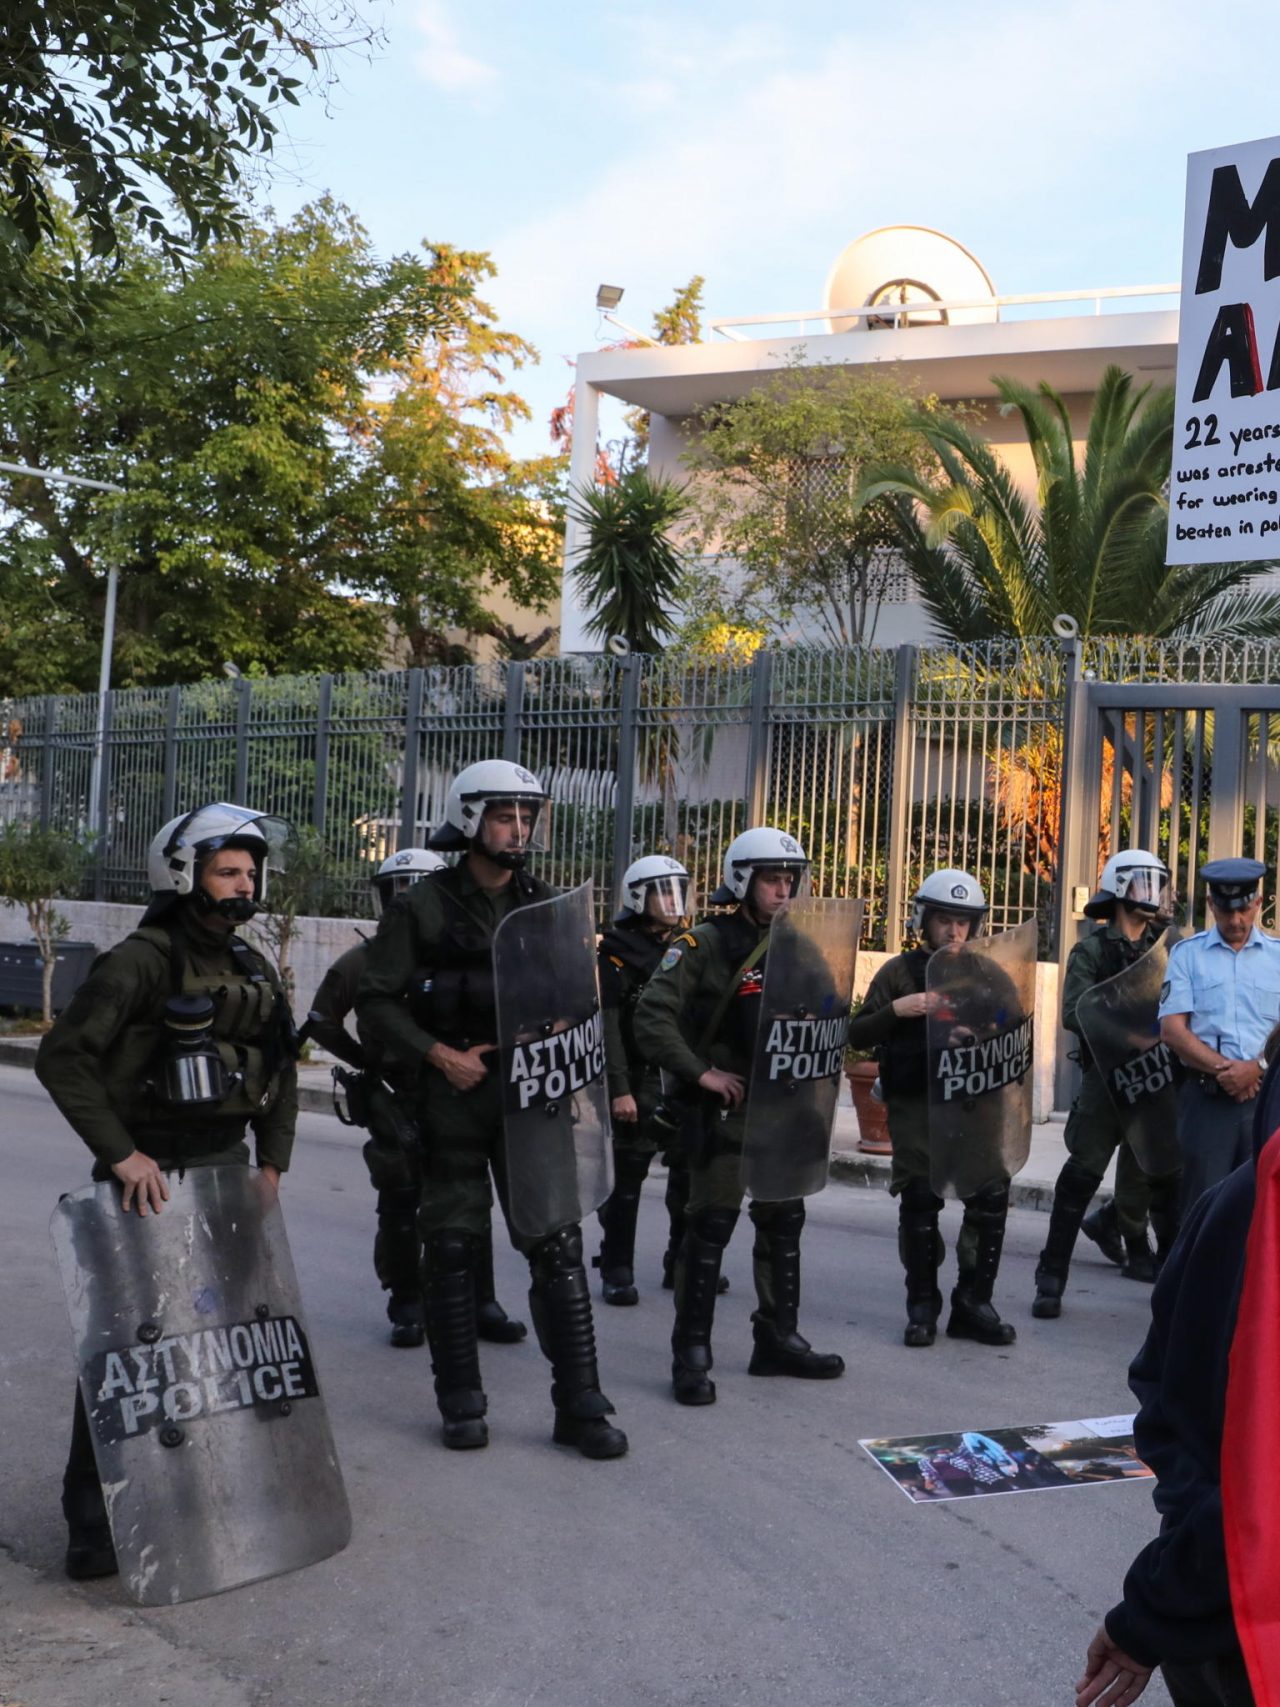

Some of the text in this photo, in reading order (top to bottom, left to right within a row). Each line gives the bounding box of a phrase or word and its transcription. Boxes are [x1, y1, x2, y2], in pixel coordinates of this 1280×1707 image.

[1184, 413, 1221, 450] 22
[1176, 467, 1210, 483] was
[1176, 491, 1204, 510] for
[1212, 487, 1278, 507] wearing
[1175, 523, 1232, 541] beaten
[1239, 519, 1254, 534] in
[510, 1011, 603, 1083] ΑΣΤΥΝΟΜ
[765, 1016, 848, 1053] ΑΣΤΥΝΟΜ
[519, 1039, 605, 1109] POLICE
[944, 1047, 1030, 1100] POLICE
[99, 1319, 304, 1401] ΑΣΤΥΝΟΜΙΑ
[120, 1361, 306, 1434] POLICE
